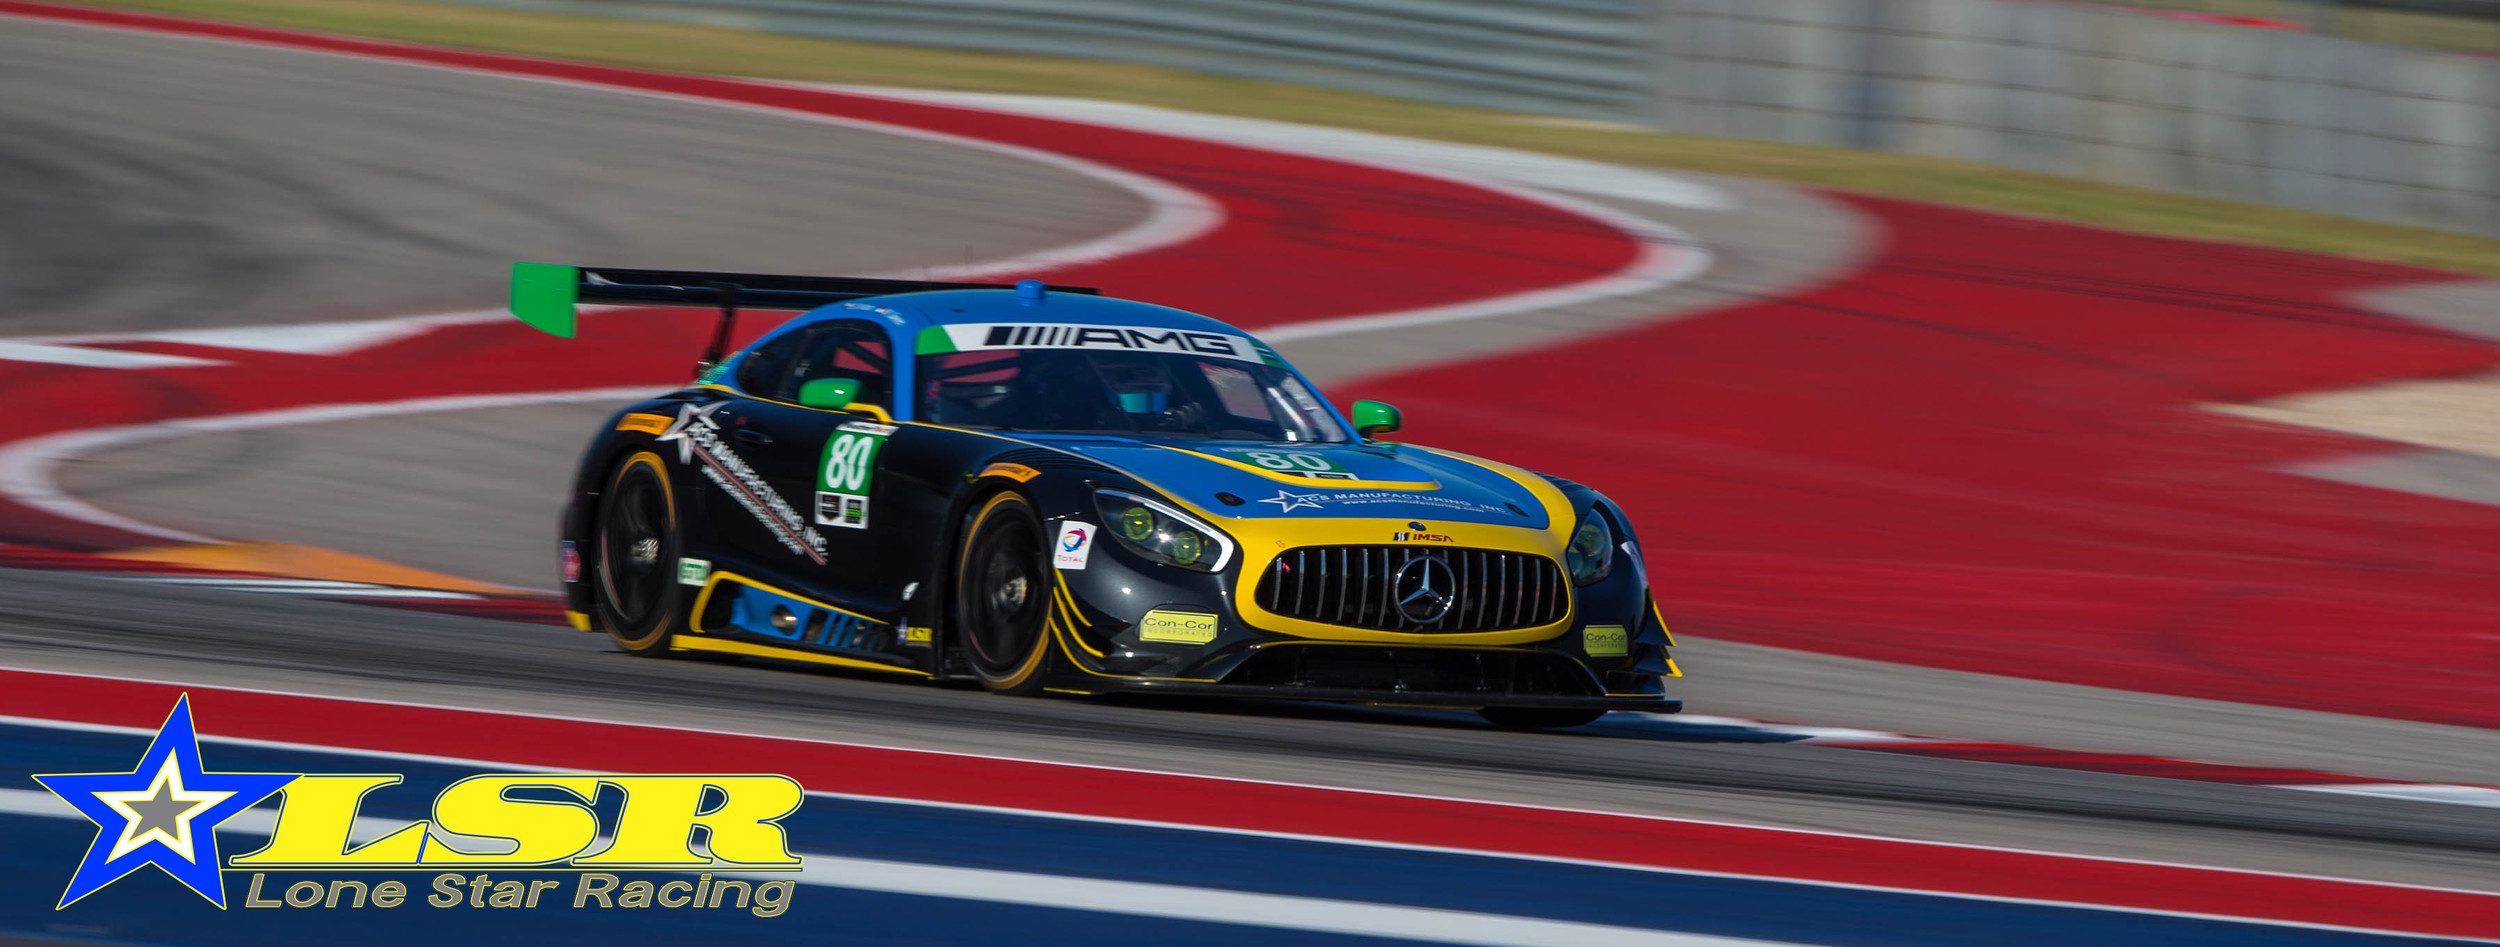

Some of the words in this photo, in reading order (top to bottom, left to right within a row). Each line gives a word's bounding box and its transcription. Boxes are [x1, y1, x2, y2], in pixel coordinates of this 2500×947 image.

[1074, 328, 1238, 356] AMG
[826, 434, 874, 490] 80
[1246, 452, 1332, 471] 80
[1297, 494, 1330, 503] ACS
[1413, 533, 1455, 543] IMSA
[1144, 617, 1213, 630] Con-Cor
